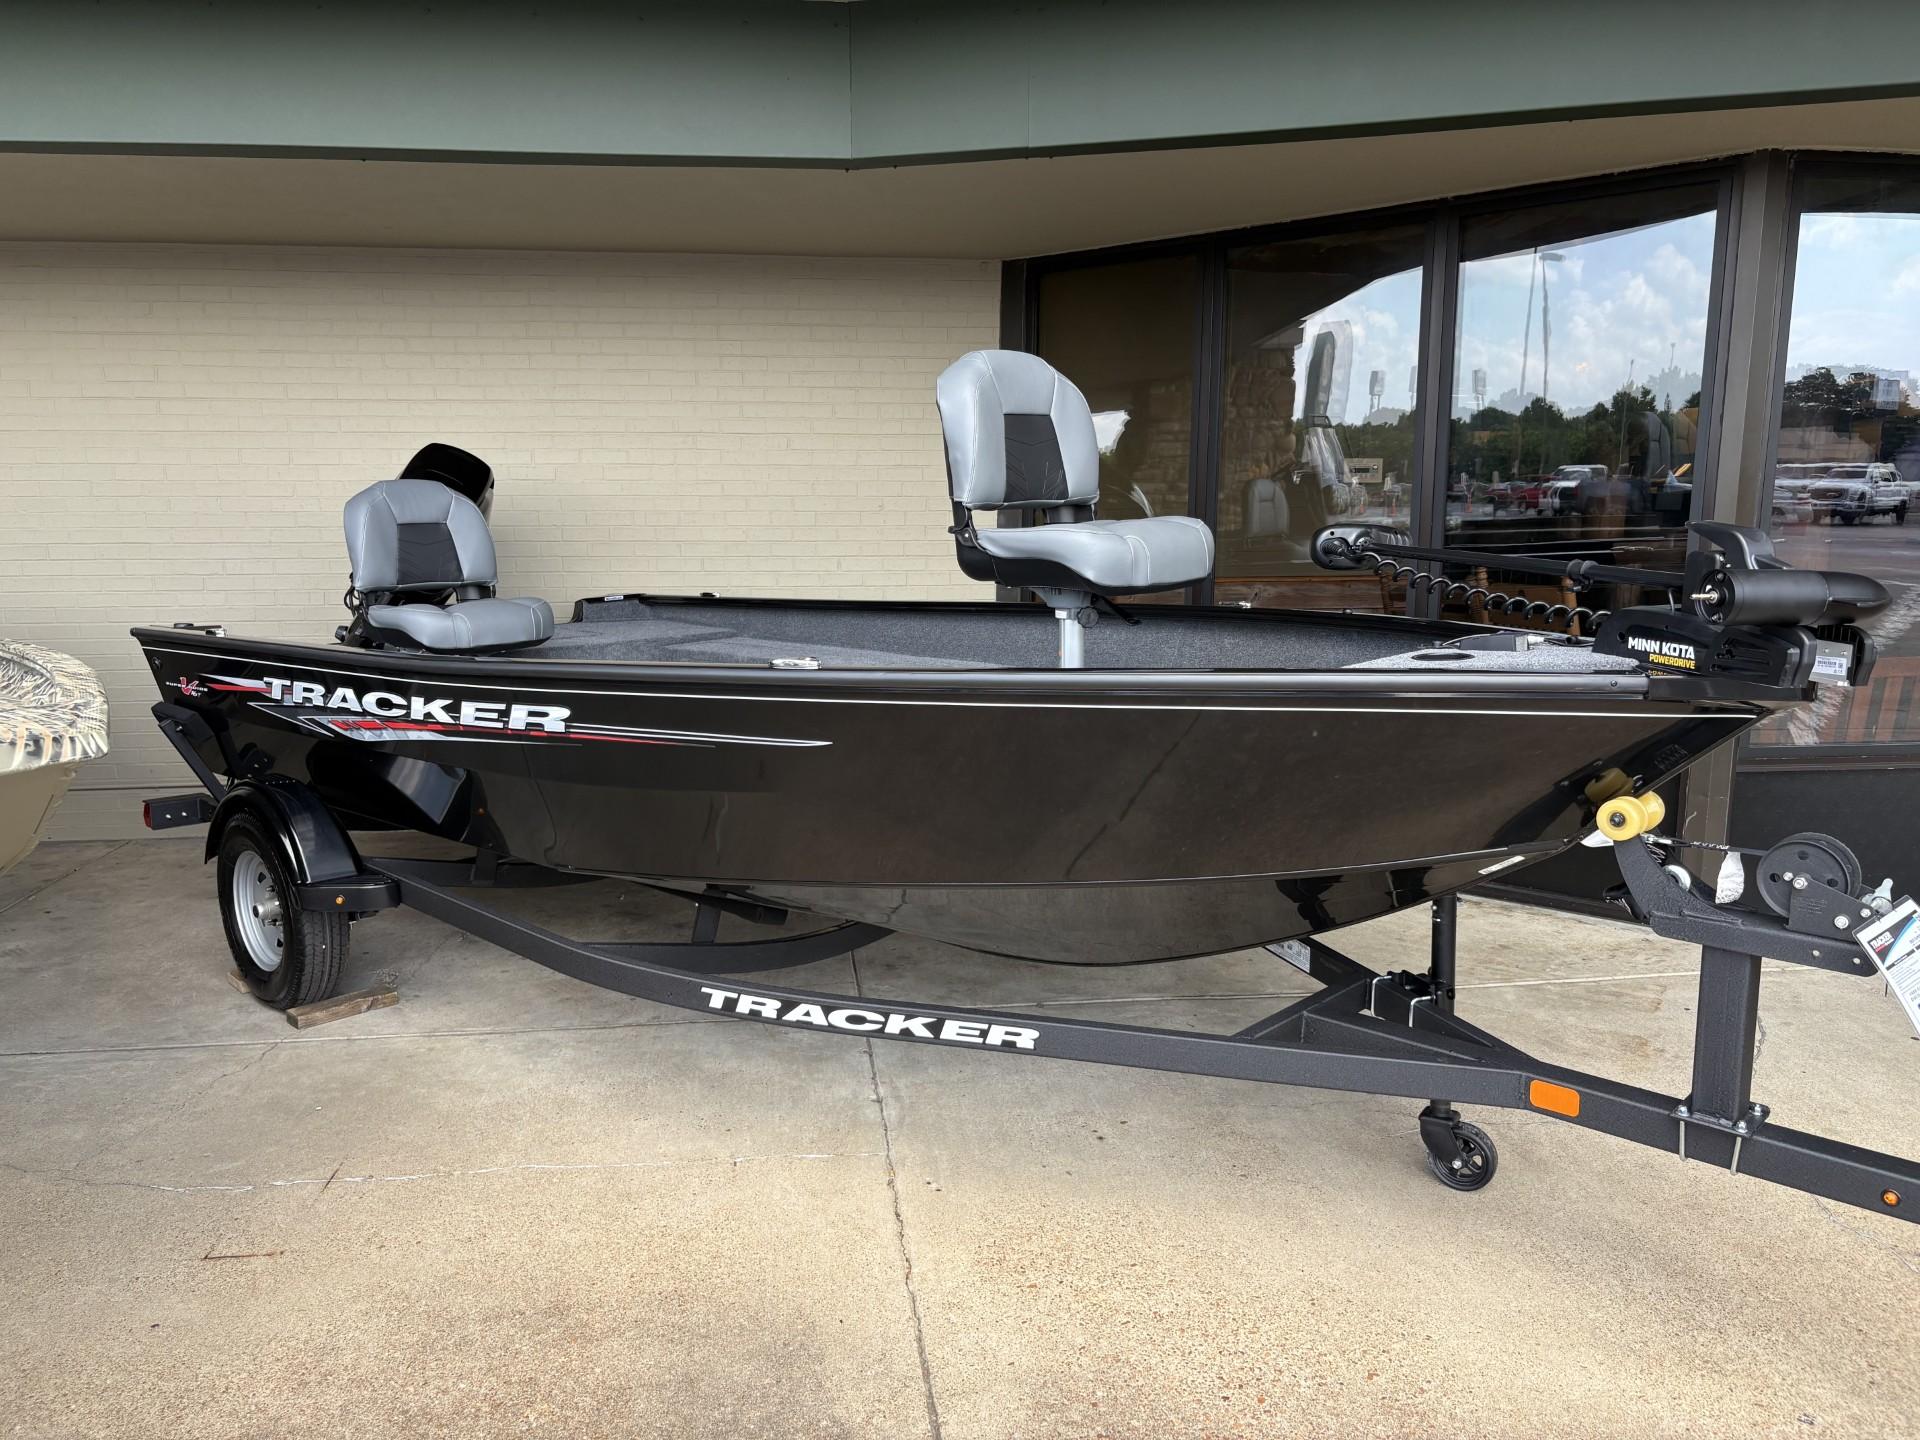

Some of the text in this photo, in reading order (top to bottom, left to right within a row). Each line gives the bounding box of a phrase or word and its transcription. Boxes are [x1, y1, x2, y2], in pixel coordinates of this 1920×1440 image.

[1627, 636, 1695, 660] MINN KOTA
[1649, 653, 1696, 670] POWERDRIVE
[263, 677, 571, 733] TRACKER
[700, 986, 1040, 1050] TRACKER
